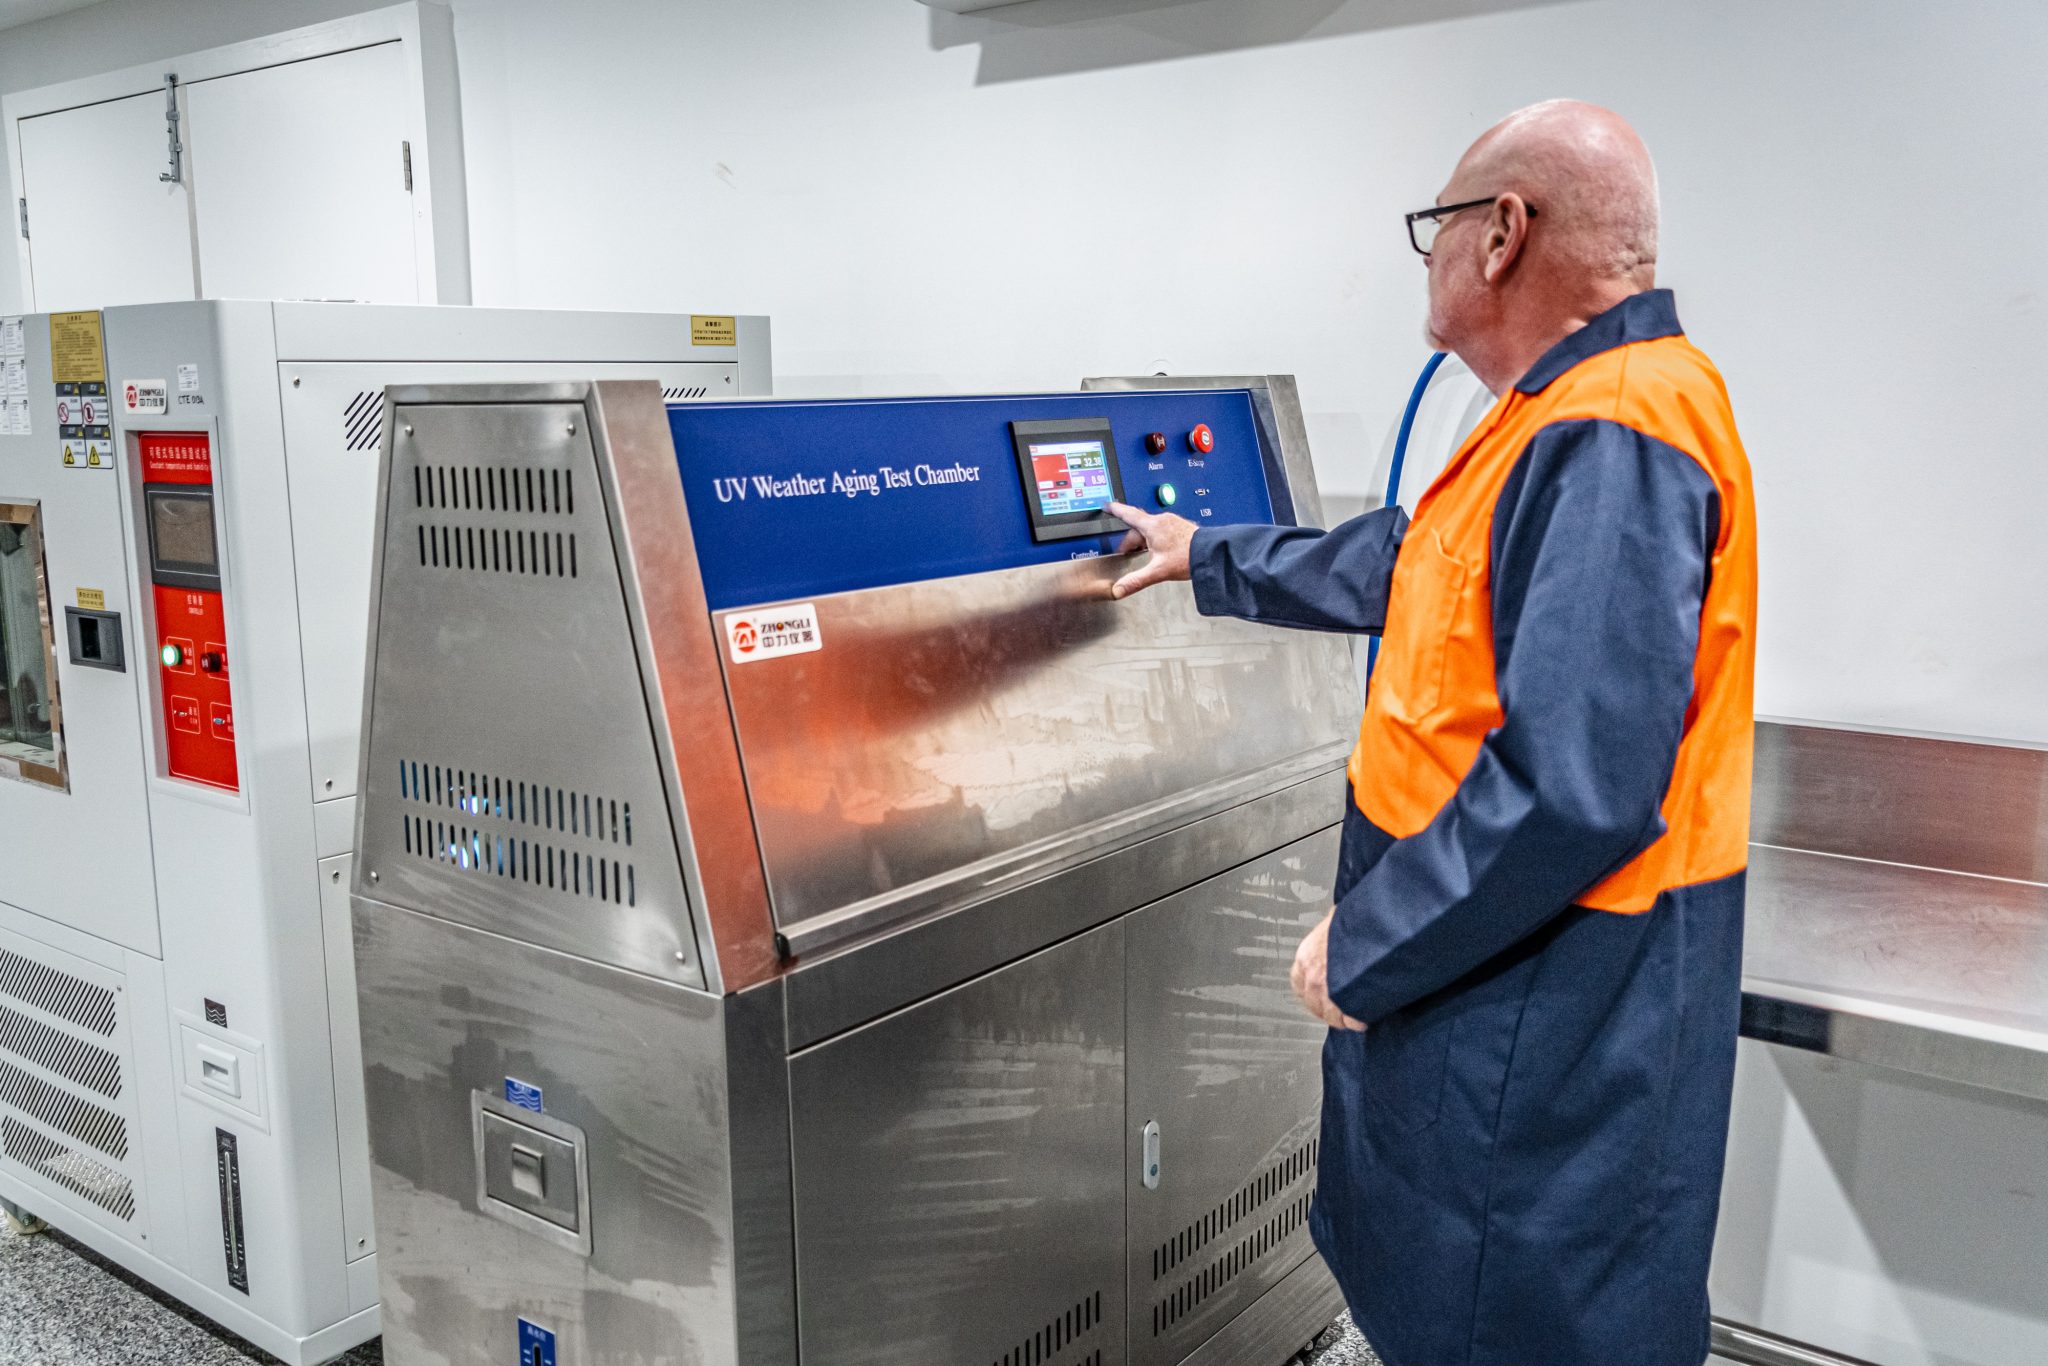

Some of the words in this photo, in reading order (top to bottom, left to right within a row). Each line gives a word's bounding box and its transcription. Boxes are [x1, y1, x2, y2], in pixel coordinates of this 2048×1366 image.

[1148, 462, 1164, 471] Alarm
[1187, 459, 1204, 468] E-Stop
[713, 477, 748, 502] UV
[752, 472, 825, 499] Weather
[832, 469, 880, 498] Aging
[880, 466, 911, 489] Test
[914, 462, 980, 485] Chamber
[1200, 508, 1212, 517] USB
[1071, 549, 1099, 560] Controller
[760, 618, 810, 634] ZHONGLI
[762, 631, 814, 648] 中力仪器
